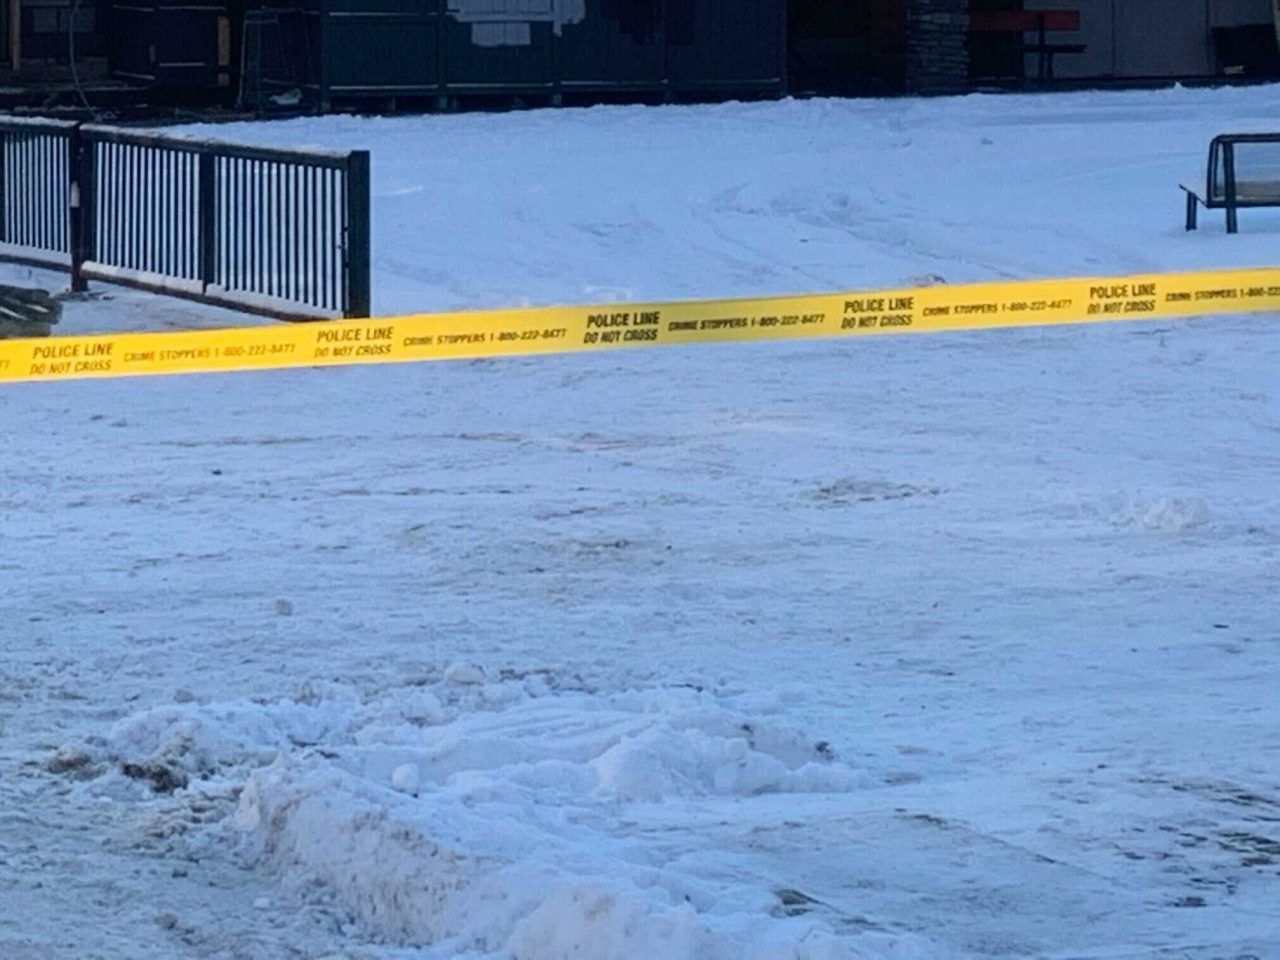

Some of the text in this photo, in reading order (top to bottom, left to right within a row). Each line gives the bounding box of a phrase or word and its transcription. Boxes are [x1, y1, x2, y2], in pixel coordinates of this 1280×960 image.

[1090, 283, 1156, 299] POLICE LINE
[844, 297, 914, 313] POLICE LINE
[1087, 300, 1156, 314] DO NOT CROSS
[587, 311, 661, 328] POLICE LINE
[841, 314, 913, 329] DO NOT CROSS
[317, 326, 394, 343] POLICE LINE
[584, 328, 658, 344] DO NOT CROSS
[33, 342, 113, 359] POLICE LINE
[314, 344, 392, 358] DO NOT CROSS
[29, 359, 112, 374] DO NOT CROSS
